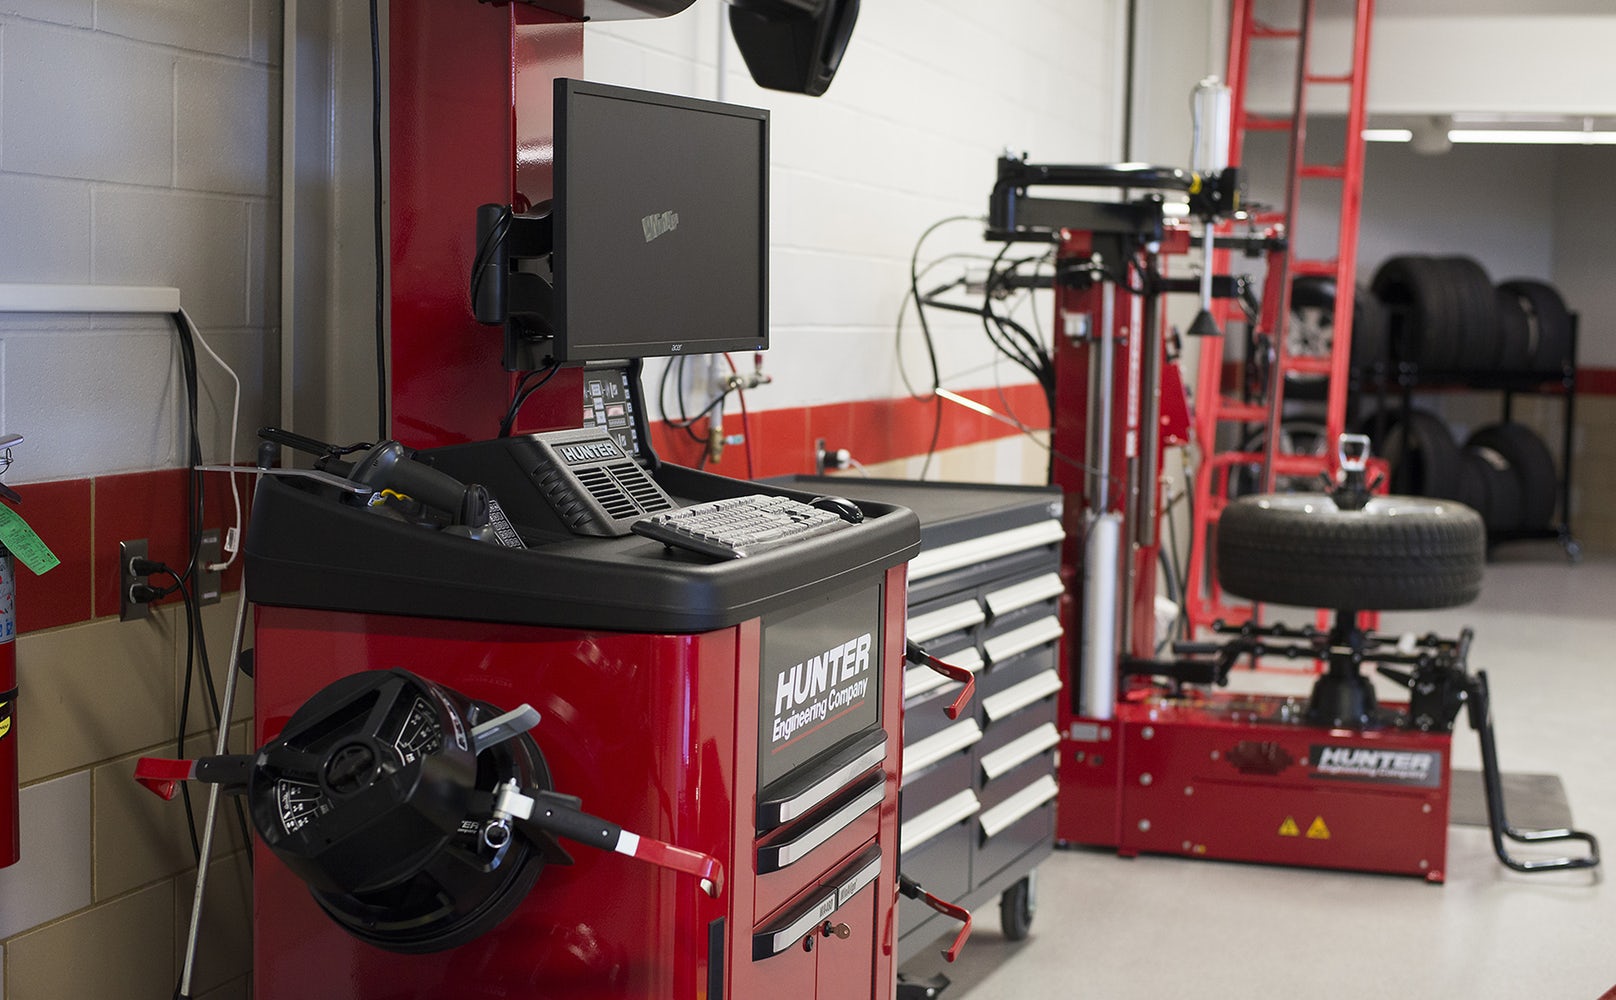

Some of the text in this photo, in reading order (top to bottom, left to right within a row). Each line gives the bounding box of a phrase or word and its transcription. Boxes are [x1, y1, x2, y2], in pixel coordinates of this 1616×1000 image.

[561, 443, 617, 461] HUNTER
[774, 633, 872, 716] HUNTER
[772, 678, 869, 742] Engineering Company
[1320, 747, 1432, 770] HUNTER
